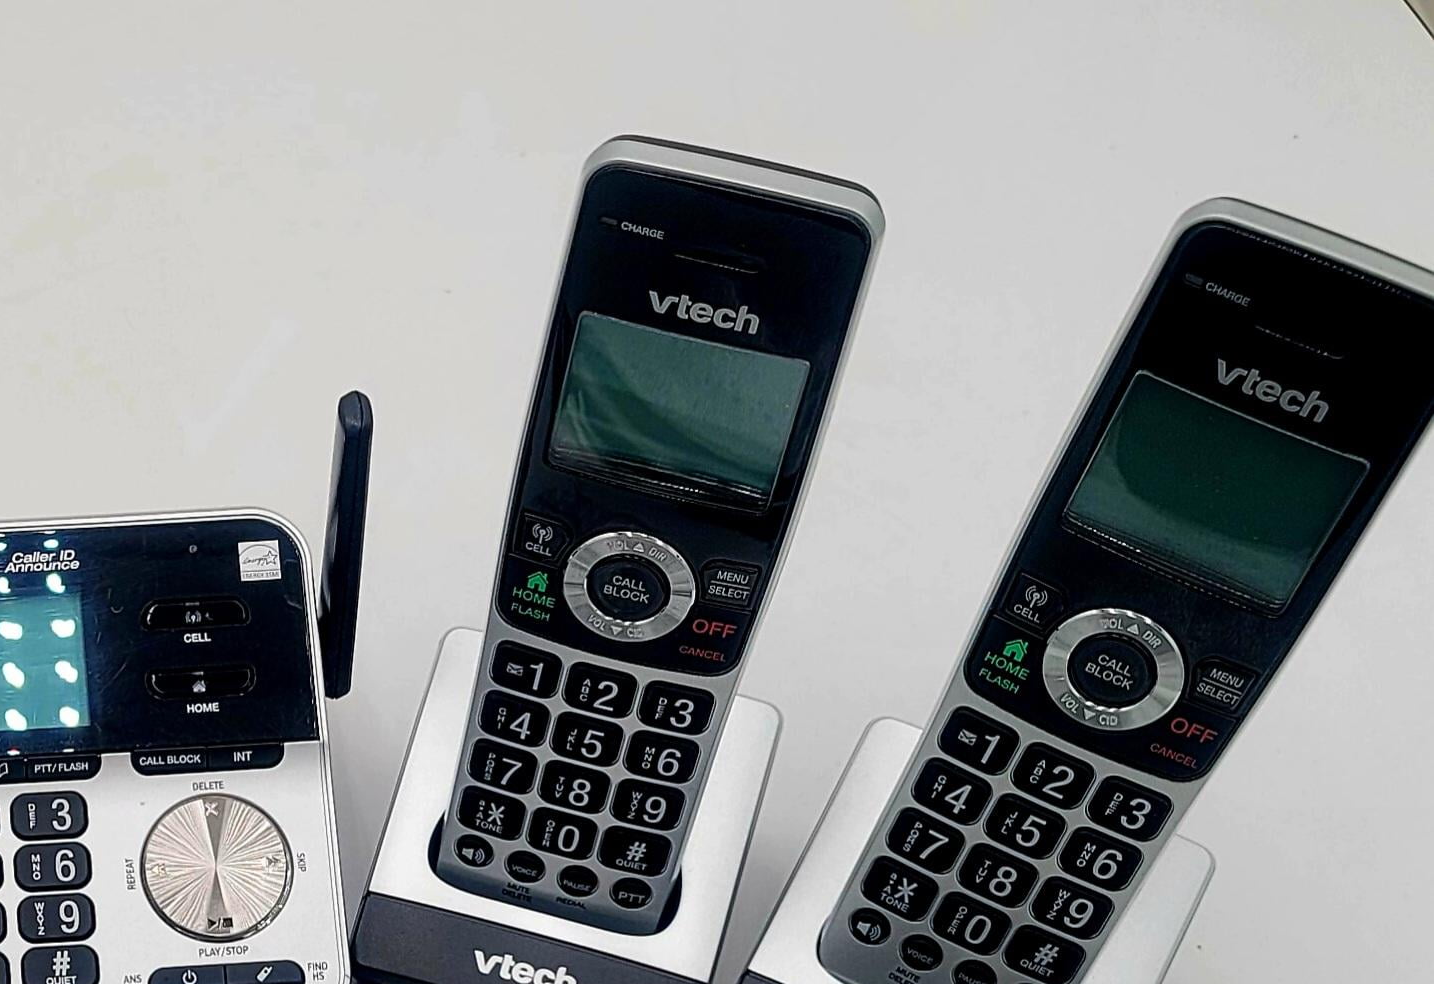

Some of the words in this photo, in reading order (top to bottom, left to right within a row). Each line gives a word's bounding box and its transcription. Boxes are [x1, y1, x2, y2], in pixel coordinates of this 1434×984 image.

[648, 290, 760, 335] vtech
[1217, 358, 1330, 423] vtech
[4, 560, 80, 573] Announce
[12, 551, 56, 563] Caller
[59, 550, 76, 561] ID
[612, 575, 646, 592] CALL
[512, 587, 556, 609] HOME
[603, 584, 650, 604] BLOCK
[183, 632, 212, 643] CELL
[692, 619, 738, 639] OFF
[984, 651, 1030, 681] HOME
[1097, 653, 1132, 678] CALL
[978, 667, 1020, 695] FLASH
[1085, 662, 1134, 691] BLOCK
[186, 702, 220, 713] HOME
[1170, 717, 1219, 744] OFF
[139, 756, 165, 766] CALL
[167, 753, 201, 765] BLOCK
[233, 751, 253, 763] INT
[192, 781, 225, 791] DELETE
[50, 798, 72, 832] 3
[55, 849, 76, 882] 6
[297, 852, 307, 872] SKIP
[124, 857, 136, 890] REPEAT
[59, 900, 80, 934] 9
[198, 945, 249, 958] PLAY/STOP
[307, 962, 328, 971] FIND
[312, 971, 325, 981] HS
[123, 975, 142, 984] ANS
